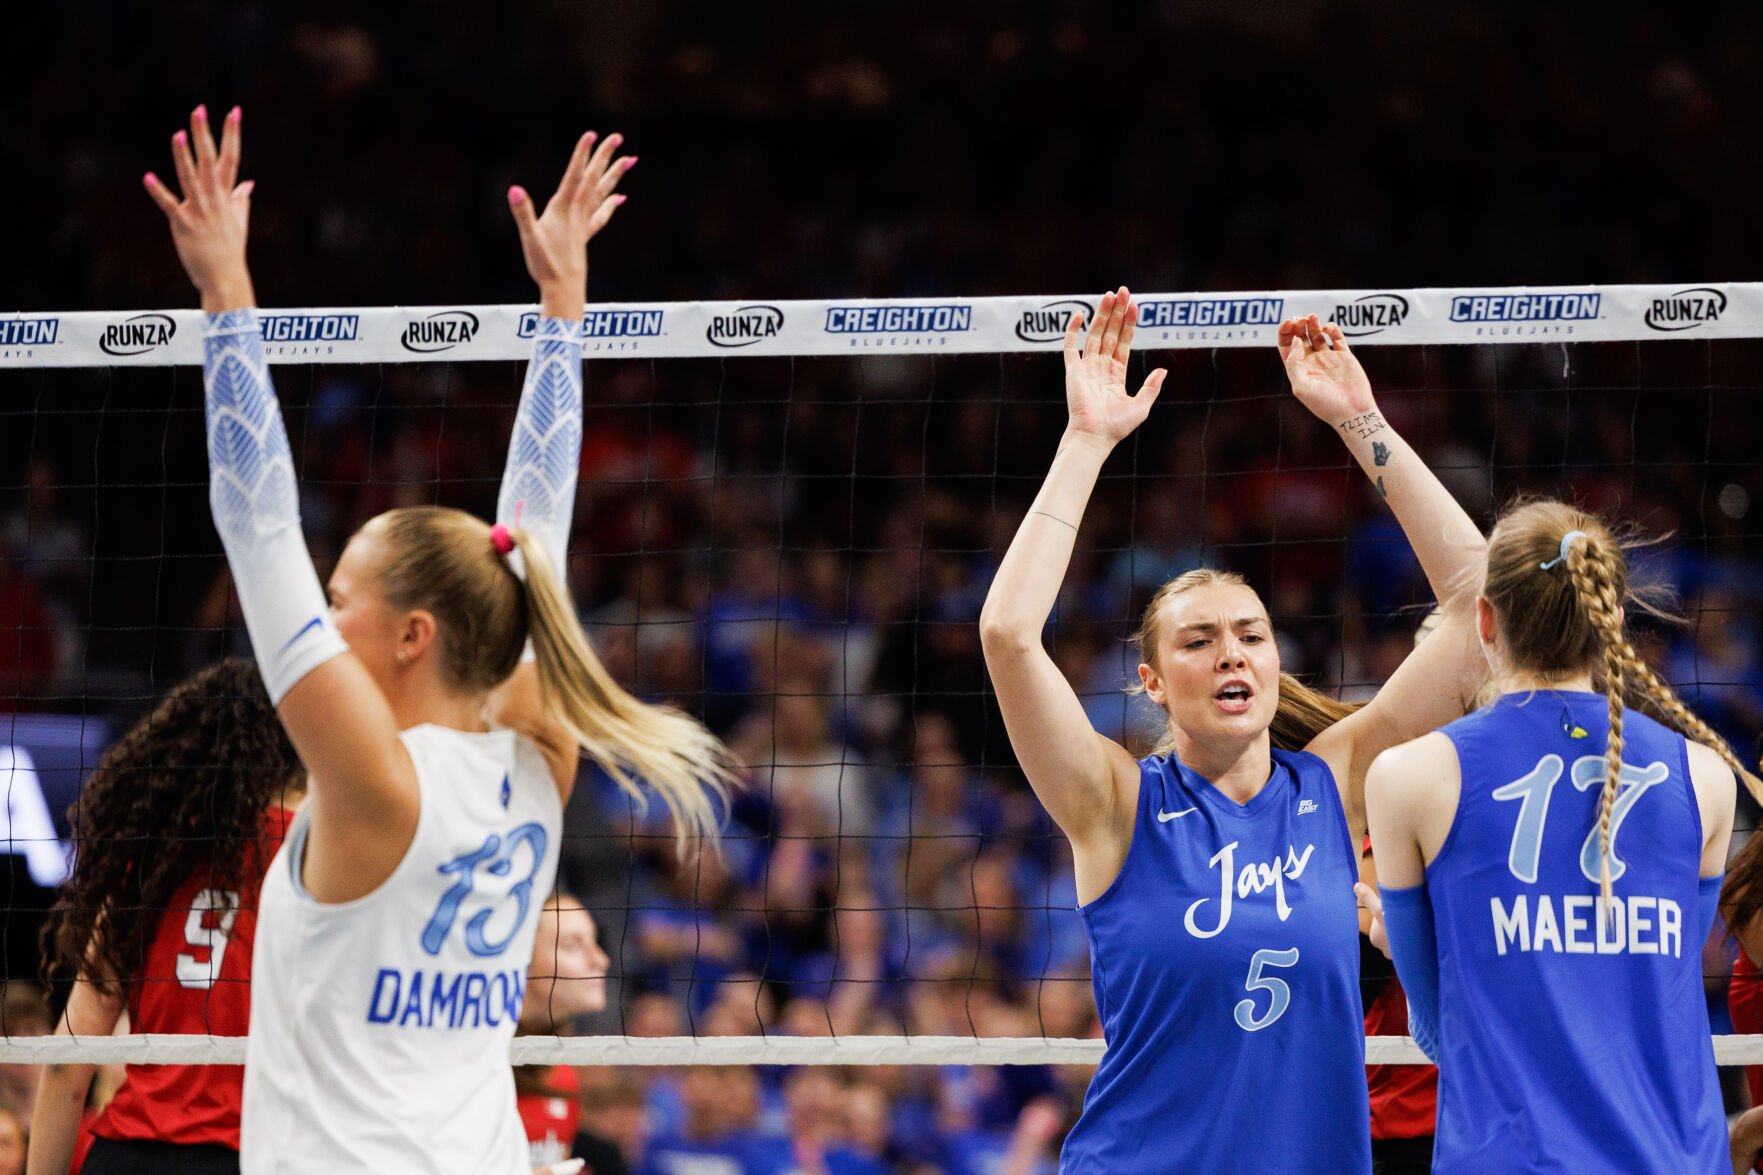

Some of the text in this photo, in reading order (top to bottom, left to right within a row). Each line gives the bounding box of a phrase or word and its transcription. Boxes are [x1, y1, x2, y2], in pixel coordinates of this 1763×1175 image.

[825, 306, 971, 333] CREIGHTON
[1137, 299, 1284, 328] CREIGHTON
[1336, 304, 1401, 327] RUNZA
[1449, 293, 1600, 322] CREIGHTON
[1653, 298, 1719, 322] RUNZA
[106, 323, 169, 347] RUNZA
[258, 315, 359, 341] IGHTON
[408, 320, 471, 343] RUNZA
[517, 310, 663, 338] CGHTON
[713, 315, 776, 338] RUNZA
[1162, 330, 1259, 340] BLUEJAYS
[1476, 325, 1575, 336] BLUEJAYS
[265, 346, 333, 355] UEJAYS
[850, 337, 947, 347] BLUEJAYS
[1491, 753, 1669, 884] 17
[420, 822, 548, 957] 13
[1184, 840, 1315, 939] Jays
[175, 887, 240, 989] 9
[1490, 894, 1682, 959] MAEDER
[1233, 947, 1300, 1032] 5
